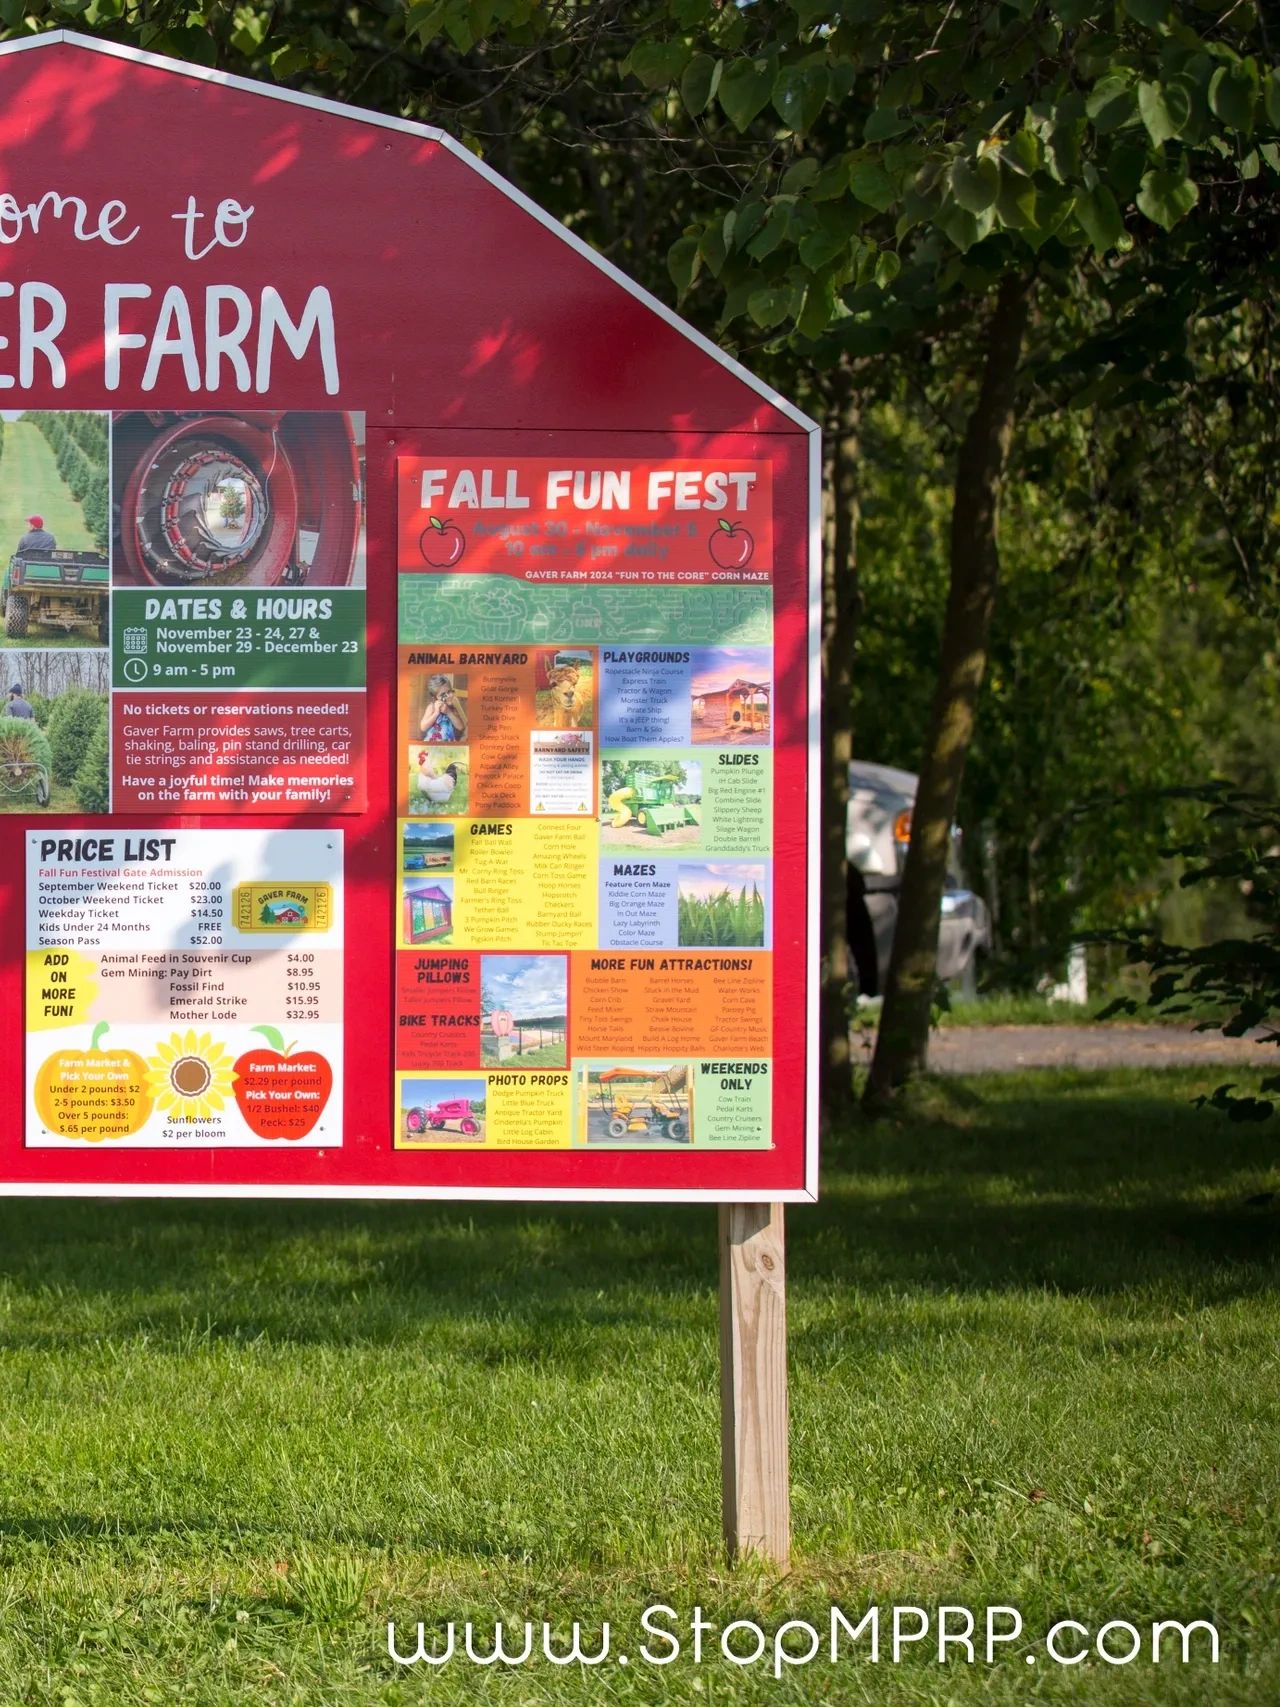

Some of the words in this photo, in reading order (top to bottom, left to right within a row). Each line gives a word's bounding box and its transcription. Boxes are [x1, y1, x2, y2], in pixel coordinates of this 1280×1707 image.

[172, 196, 254, 260] to
[104, 284, 339, 395] FARM
[421, 470, 529, 508] FALL
[546, 471, 630, 510] FUN
[648, 471, 756, 510] FEST
[590, 571, 612, 579] 2024
[678, 572, 709, 580] CORE"
[712, 572, 740, 580] CORN
[743, 572, 768, 580] MAZE
[146, 599, 221, 620] DATES
[230, 599, 247, 619] &
[257, 598, 332, 619] HOURS
[157, 627, 232, 639] November
[236, 628, 252, 639] 23
[265, 628, 284, 641] 24,
[289, 627, 305, 638] 27
[309, 628, 320, 639] &
[157, 641, 232, 652] November
[236, 641, 252, 652] 29
[265, 641, 338, 652] December
[342, 641, 358, 652] 23
[408, 653, 454, 664] ANIMAL
[459, 654, 528, 664] BARNYARD
[604, 652, 689, 663] PLAYGROUNDS
[154, 664, 161, 675] 9
[166, 666, 187, 675] am
[201, 664, 208, 675] 5
[213, 666, 235, 678] pm
[124, 704, 141, 714] No
[146, 704, 190, 714] tickets
[194, 706, 207, 714] or
[212, 704, 293, 714] reservations
[297, 704, 348, 714] needed!
[719, 754, 758, 765] SLIDES
[122, 776, 155, 786] Have
[159, 778, 166, 786] a
[168, 775, 206, 789] joyful
[210, 775, 244, 786] time!
[249, 775, 284, 786] Make
[288, 775, 354, 785] memories
[138, 792, 154, 800] on
[158, 788, 180, 800] the
[182, 788, 215, 800] farm
[219, 789, 248, 800] with
[252, 792, 282, 803] your
[285, 789, 330, 802] family!
[471, 824, 512, 835] GAMES
[41, 839, 114, 861] PRICE
[124, 839, 176, 861] LIST
[614, 865, 656, 876] MAZES
[39, 882, 94, 893] September
[97, 882, 144, 890] Weekend
[148, 882, 178, 890] Ticket
[190, 882, 221, 890] $20.00
[39, 896, 80, 904] October
[83, 896, 129, 904] Weekend
[134, 896, 164, 904] Ticket
[191, 896, 222, 904] $23.00
[258, 890, 284, 904] GAVER
[286, 890, 309, 904] FARM
[39, 910, 85, 920] Weekday
[191, 909, 222, 917] $14.50
[40, 923, 60, 931] Kids
[64, 923, 94, 931] Under
[98, 923, 108, 931] 24
[112, 923, 150, 931] Months
[39, 937, 74, 945] Season
[190, 936, 222, 944] $52.00
[44, 955, 69, 965] ADD
[414, 959, 468, 970] JUMPING
[591, 959, 625, 970] MORE
[630, 959, 654, 970] FUN
[660, 959, 752, 970] ATTRACTIONS!
[51, 972, 66, 982] ON
[418, 972, 470, 983] PILLOWS
[42, 988, 76, 999] MORE
[44, 1006, 73, 1016] FUN!
[400, 1015, 426, 1026] BIKE
[432, 1015, 480, 1026] TRACKS
[701, 1063, 767, 1074] WEEKENDS
[488, 1075, 526, 1085] PHOTO
[531, 1075, 568, 1085] PROPS
[721, 1079, 752, 1090] ONLY
